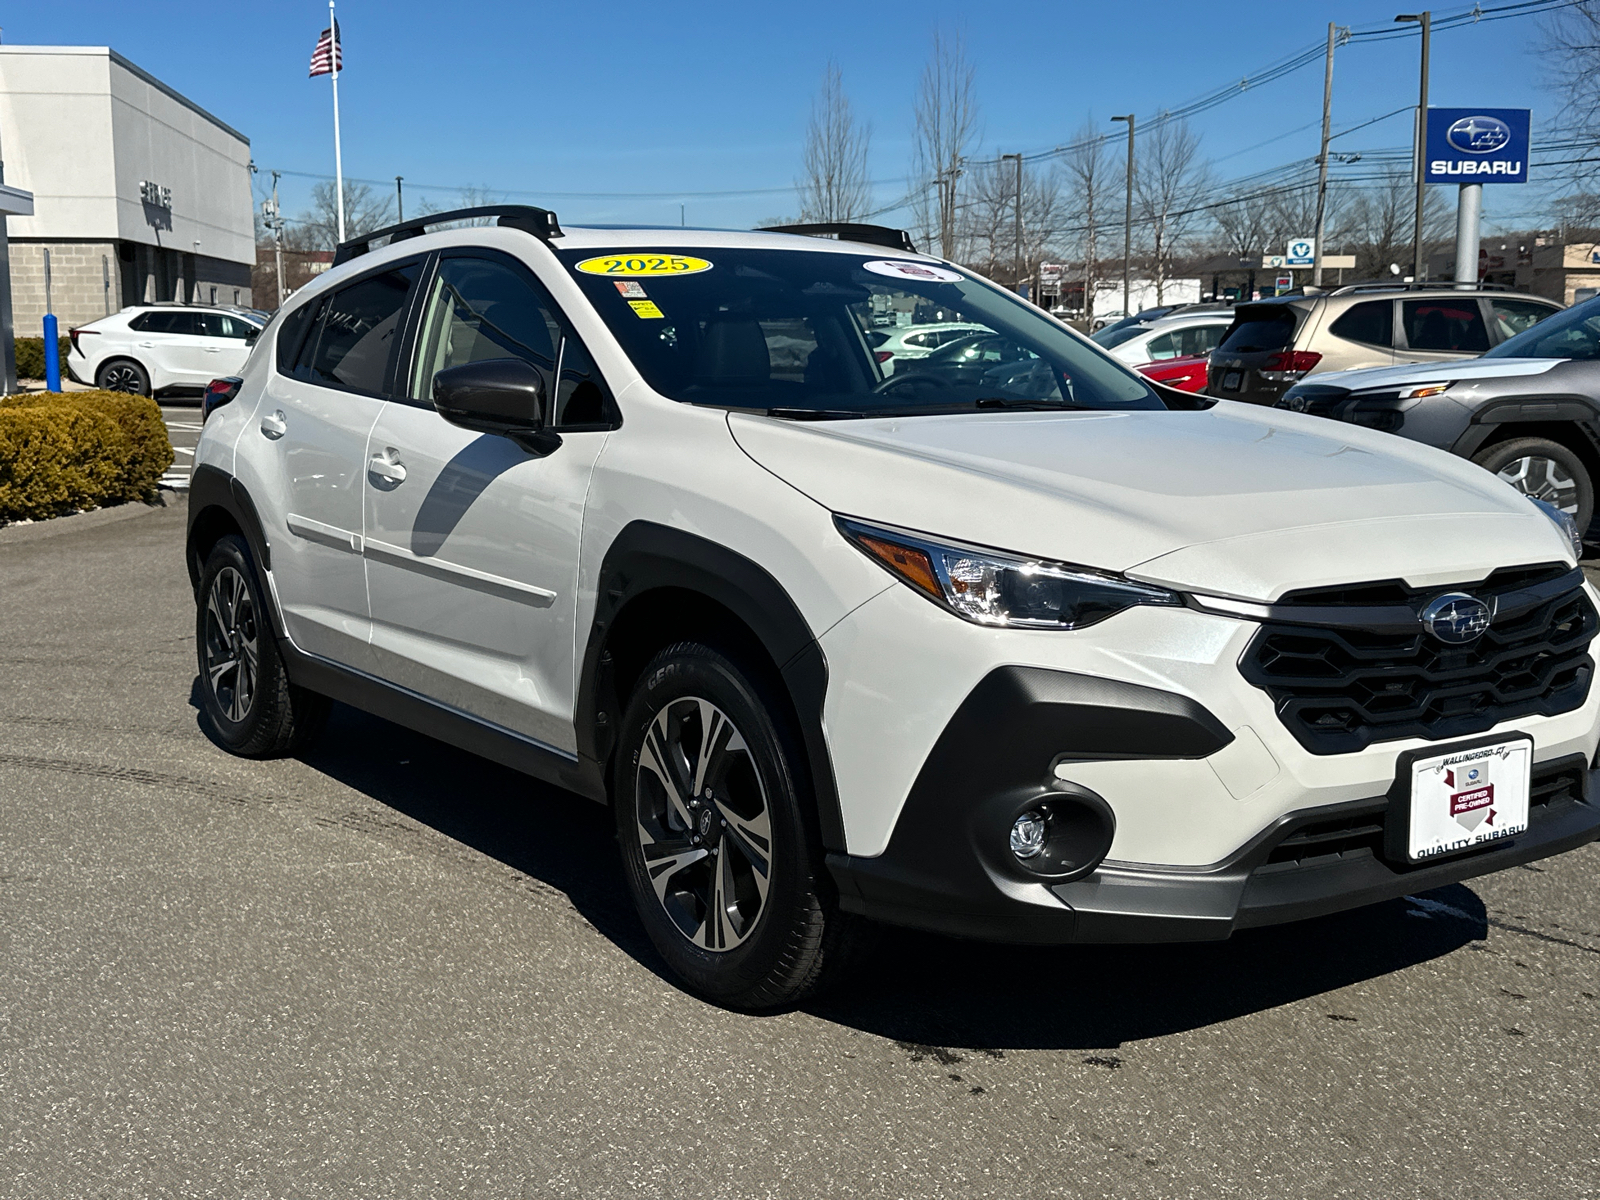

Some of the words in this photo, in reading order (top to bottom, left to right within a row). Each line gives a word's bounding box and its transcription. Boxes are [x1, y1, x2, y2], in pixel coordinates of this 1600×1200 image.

[1431, 161, 1520, 175] SUBARU
[604, 258, 690, 273] 2025
[1465, 779, 1482, 787] SUBARU
[1457, 790, 1488, 803] CERTIFIED
[1454, 797, 1490, 811] PRE-OWNED
[1417, 838, 1471, 858] QUALITY
[1475, 824, 1525, 844] SUBARU
